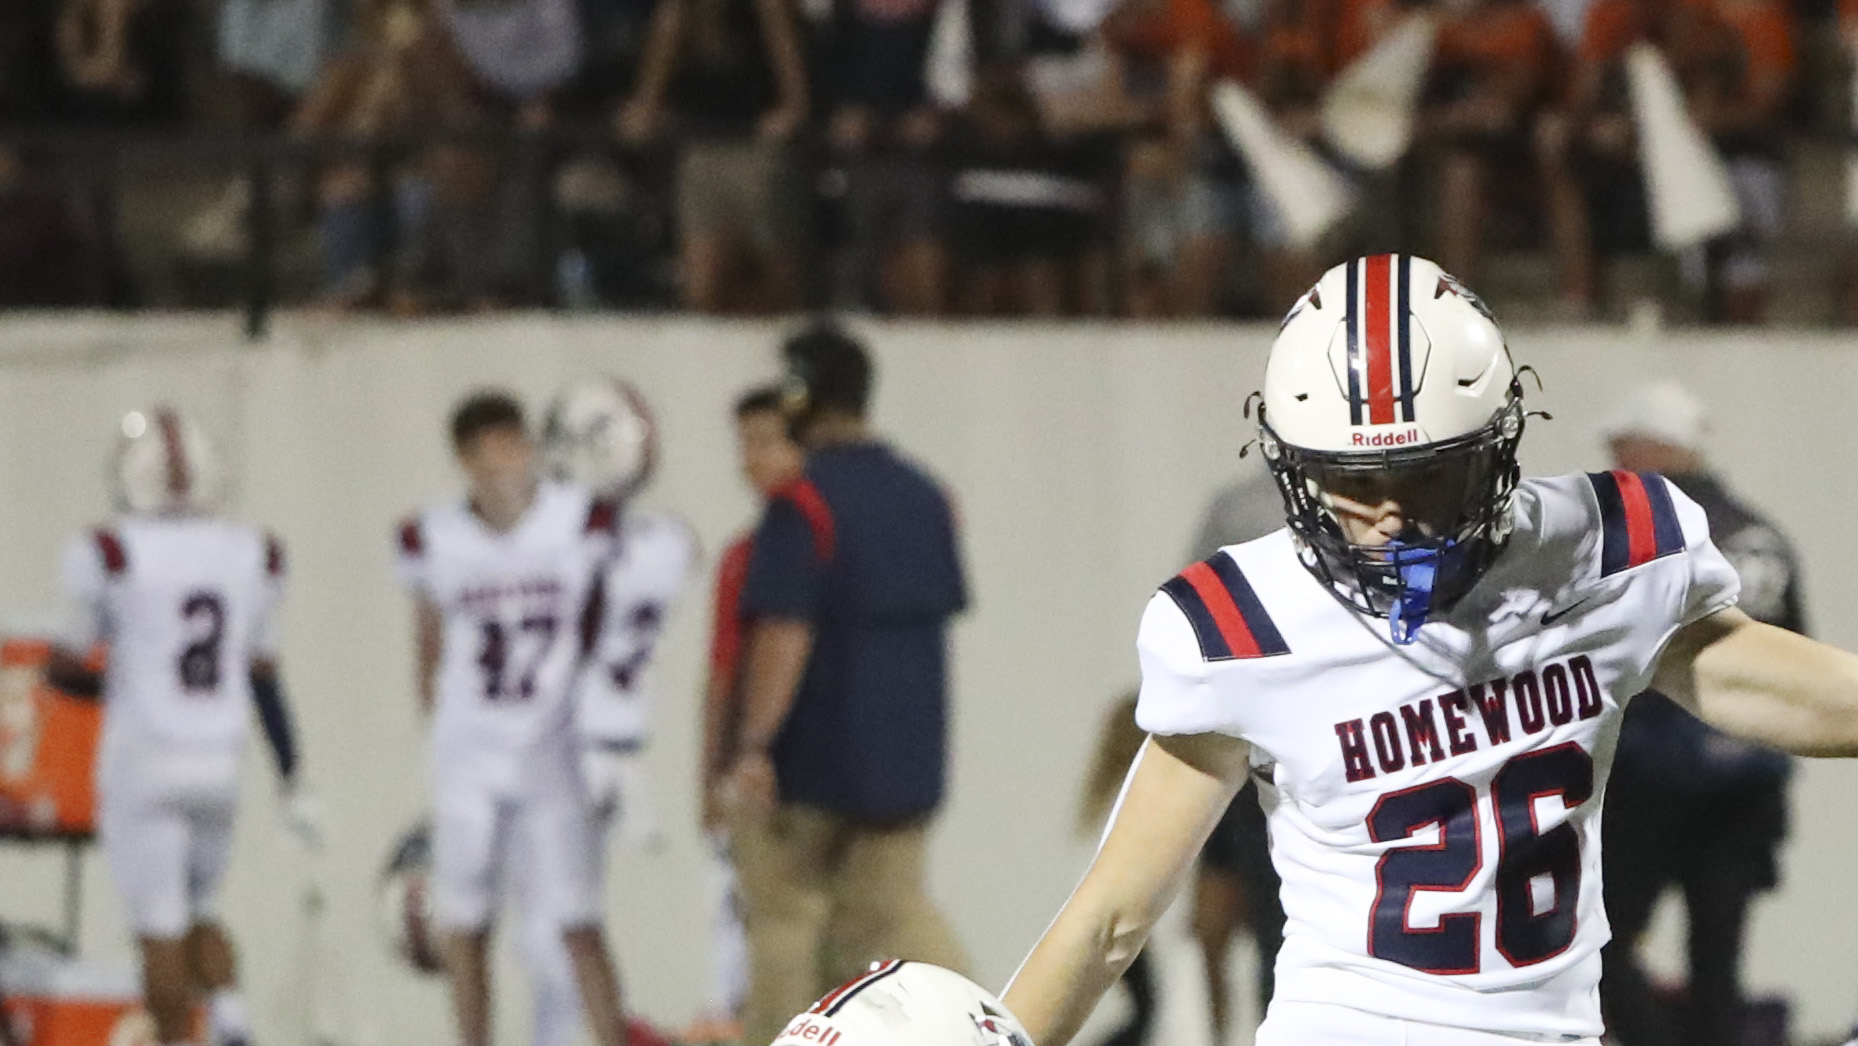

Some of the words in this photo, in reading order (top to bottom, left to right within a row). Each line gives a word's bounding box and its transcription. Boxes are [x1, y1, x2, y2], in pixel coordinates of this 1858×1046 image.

[1352, 429, 1418, 446] Riddell
[177, 594, 230, 695] 2
[1335, 654, 1603, 783] HOMEWOOD
[1367, 741, 1596, 976] 26
